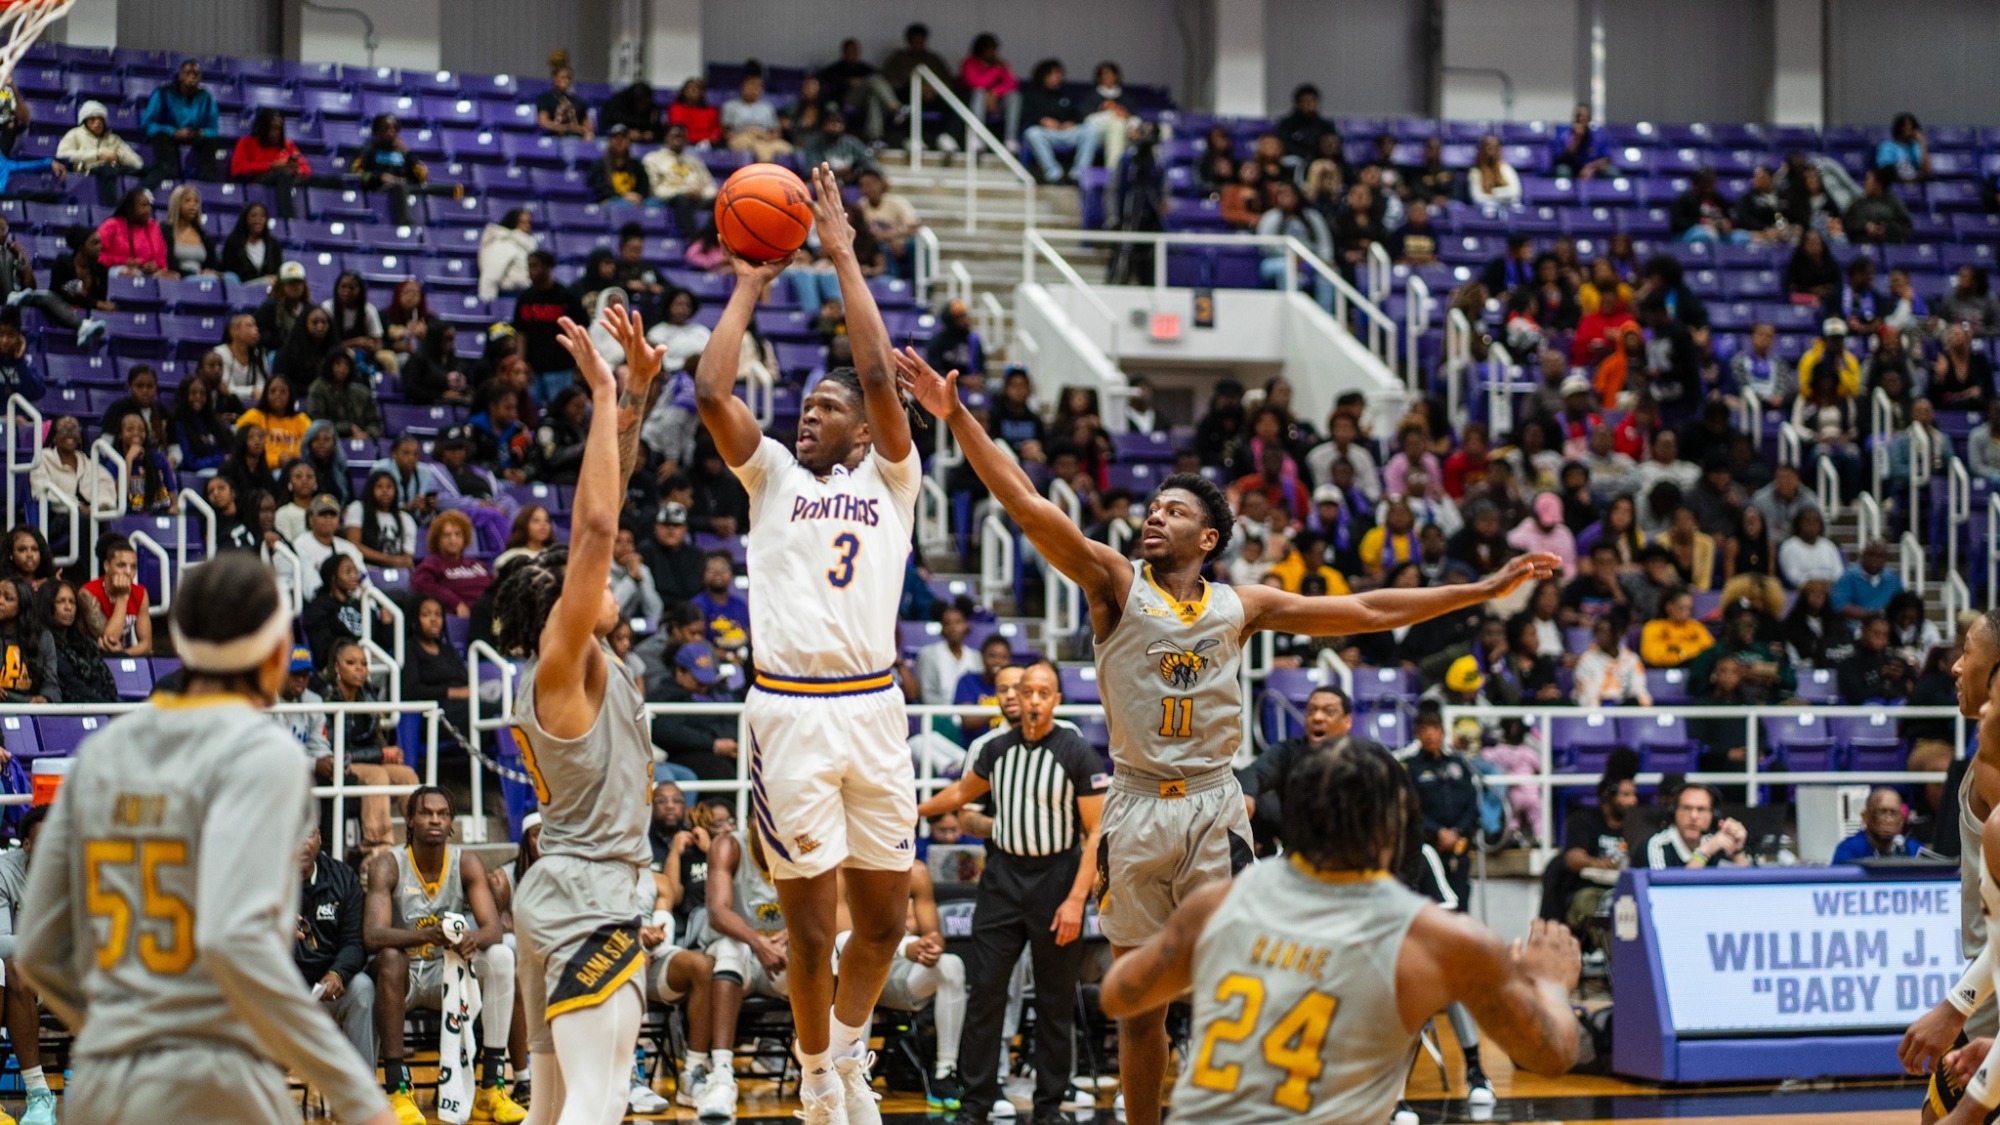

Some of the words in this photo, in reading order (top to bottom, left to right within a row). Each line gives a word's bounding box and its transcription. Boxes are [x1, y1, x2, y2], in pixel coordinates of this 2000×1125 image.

[791, 493, 879, 527] PANTHRS
[827, 531, 861, 589] 3
[1159, 697, 1193, 737] 11
[84, 839, 196, 975] 55
[1812, 889, 1950, 917] WELCOME
[576, 953, 614, 988] BAMA
[1706, 930, 1889, 972] WILLIAM
[1902, 929, 1940, 968] J.
[1752, 976, 1881, 1014] "BABY
[1193, 972, 1338, 1114] 24
